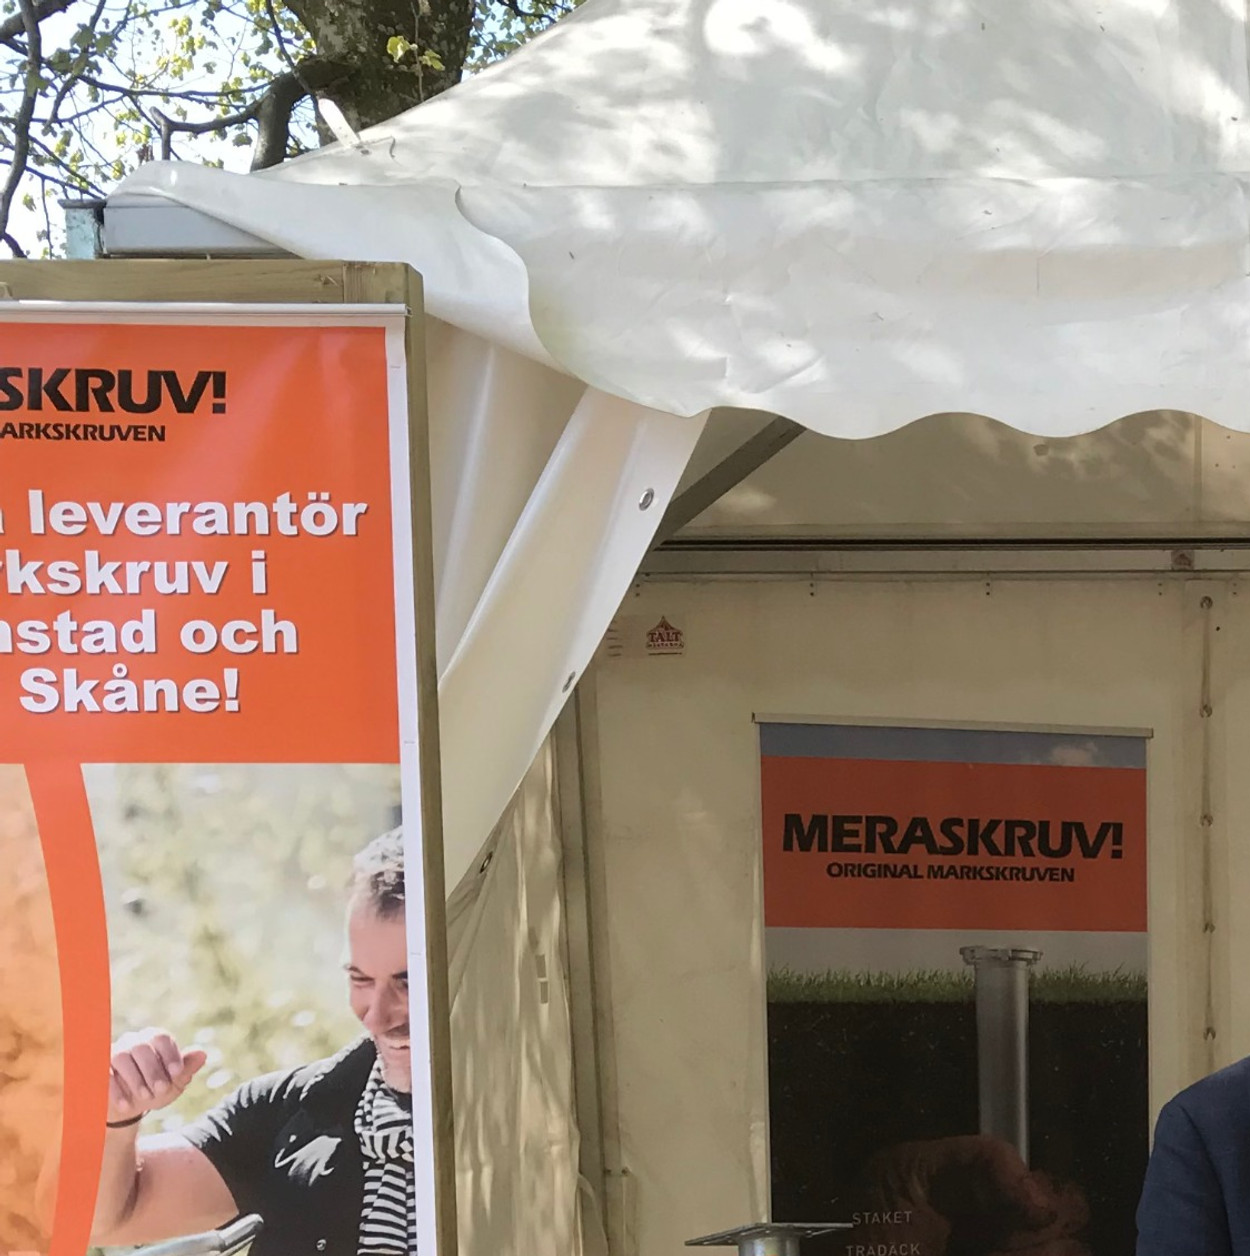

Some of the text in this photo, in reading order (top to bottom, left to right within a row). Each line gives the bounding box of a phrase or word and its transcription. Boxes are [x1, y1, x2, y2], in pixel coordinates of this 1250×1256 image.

[28, 489, 368, 537] leverantör
[0, 549, 268, 595] kskruv i
[180, 609, 298, 654] och
[19, 662, 240, 713] Skåne!
[783, 813, 1123, 859] MERASKRUV!
[826, 861, 1075, 882] ORIGINAL MARKSKRUVEN
[852, 1210, 913, 1226] STAKET
